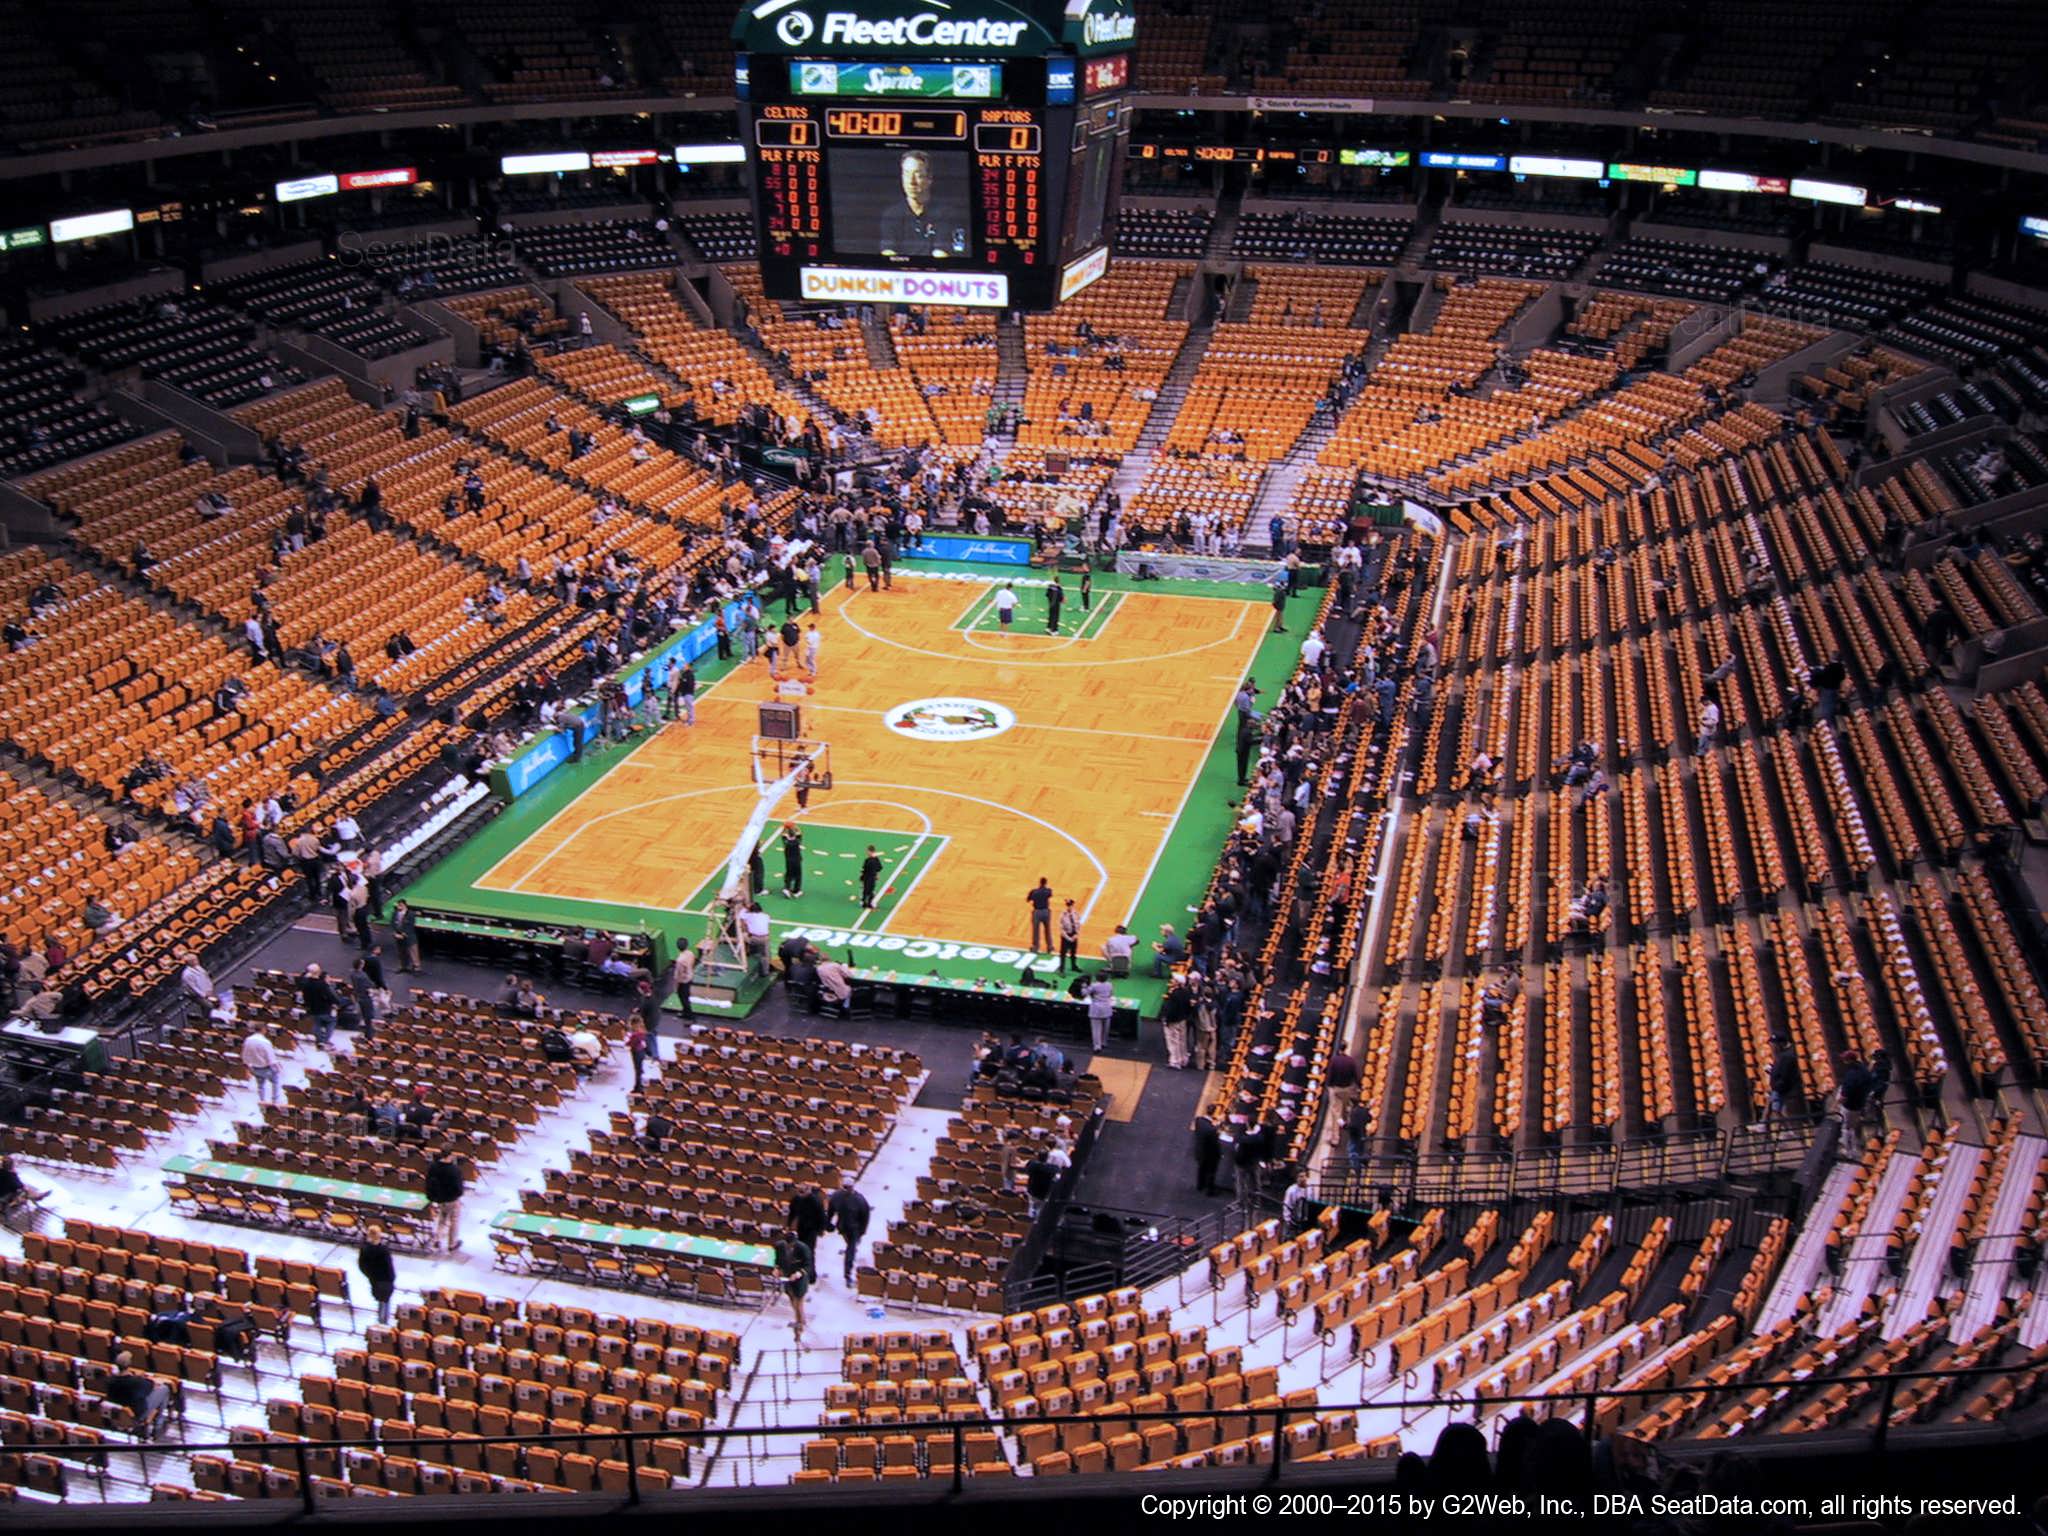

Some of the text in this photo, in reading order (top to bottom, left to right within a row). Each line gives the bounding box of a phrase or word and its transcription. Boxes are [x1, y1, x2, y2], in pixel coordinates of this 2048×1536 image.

[822, 12, 1028, 46] FleetCenter
[863, 68, 924, 94] Sprite
[764, 106, 809, 119] CELTICS
[981, 110, 1032, 124] RAPTORS
[790, 123, 807, 145] 0
[829, 112, 965, 137] 40:00 1
[1010, 128, 1029, 150] 0
[761, 150, 820, 163] PLR F PTS
[979, 155, 1040, 168] PLR F PTS
[807, 274, 1000, 299] DUNKIN' DONUTS
[780, 926, 1063, 973] FleetCenter
